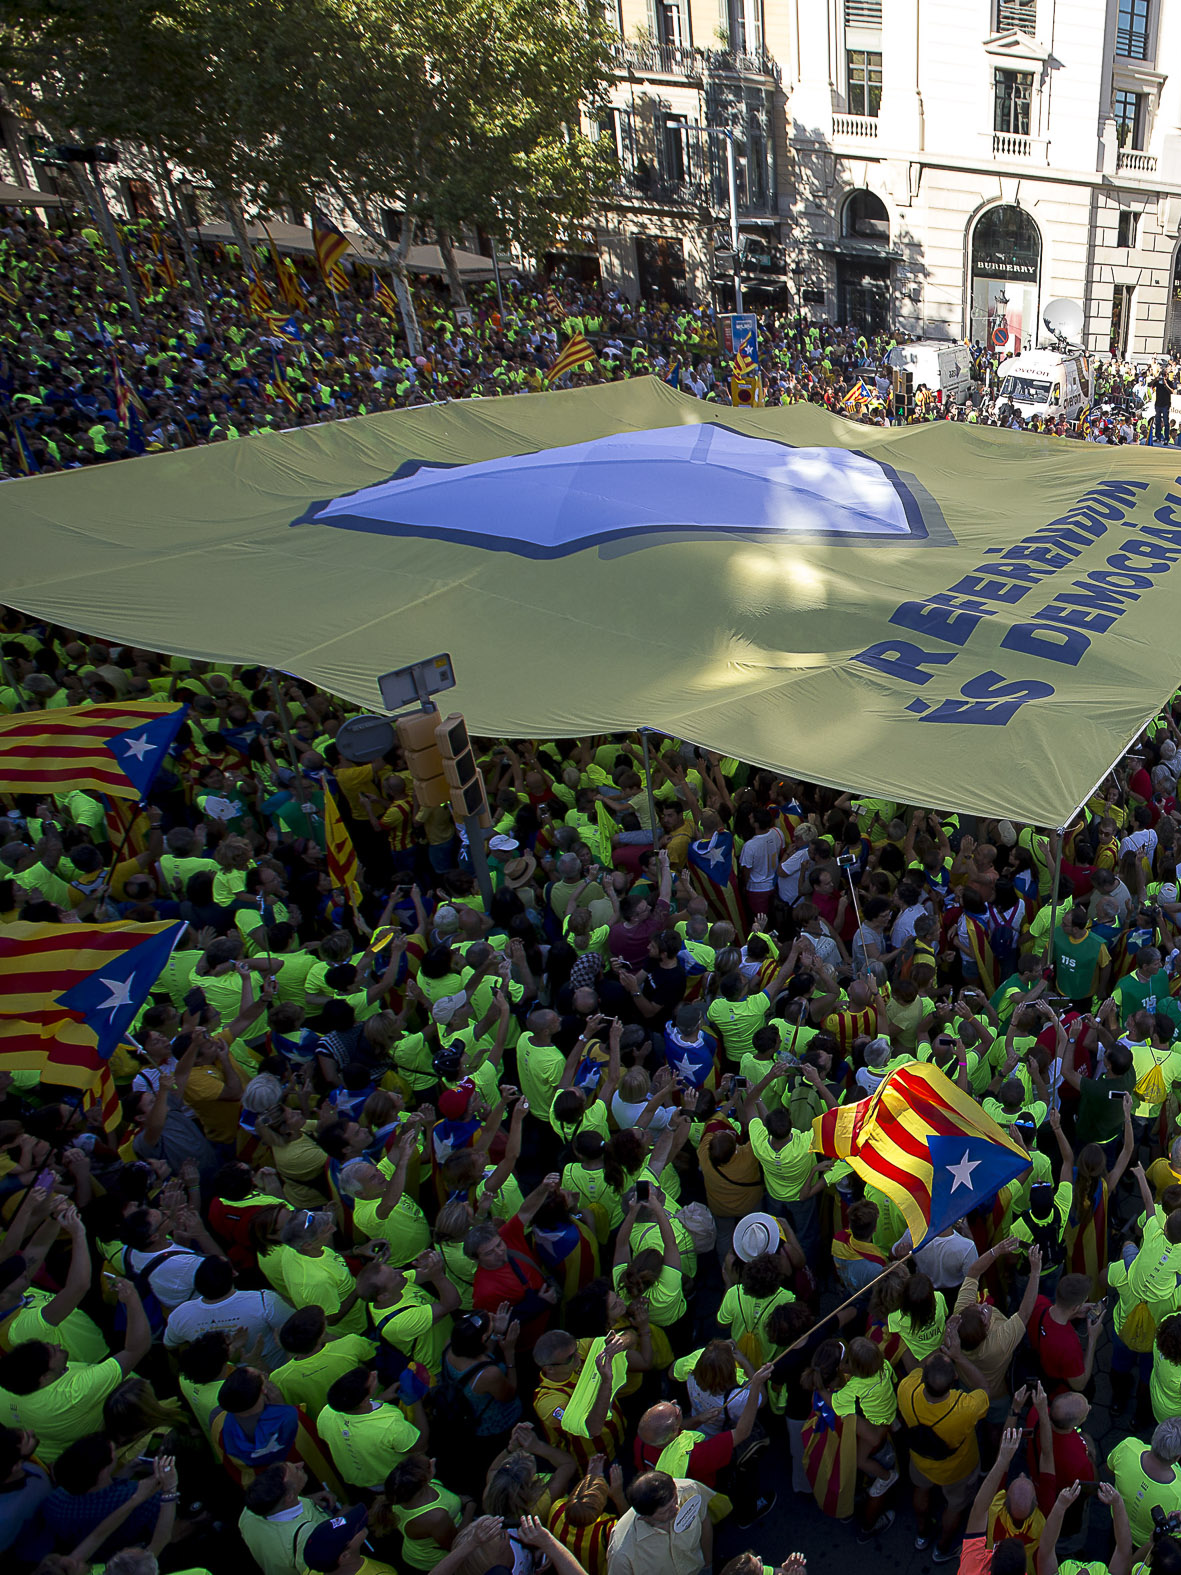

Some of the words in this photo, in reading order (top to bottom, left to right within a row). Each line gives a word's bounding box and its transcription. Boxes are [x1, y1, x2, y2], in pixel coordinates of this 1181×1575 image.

[977, 261, 1036, 274] BURBERRY
[1015, 367, 1050, 377] overon
[1061, 955, 1076, 967] 11S
[918, 1327, 943, 1342] SILVIA
